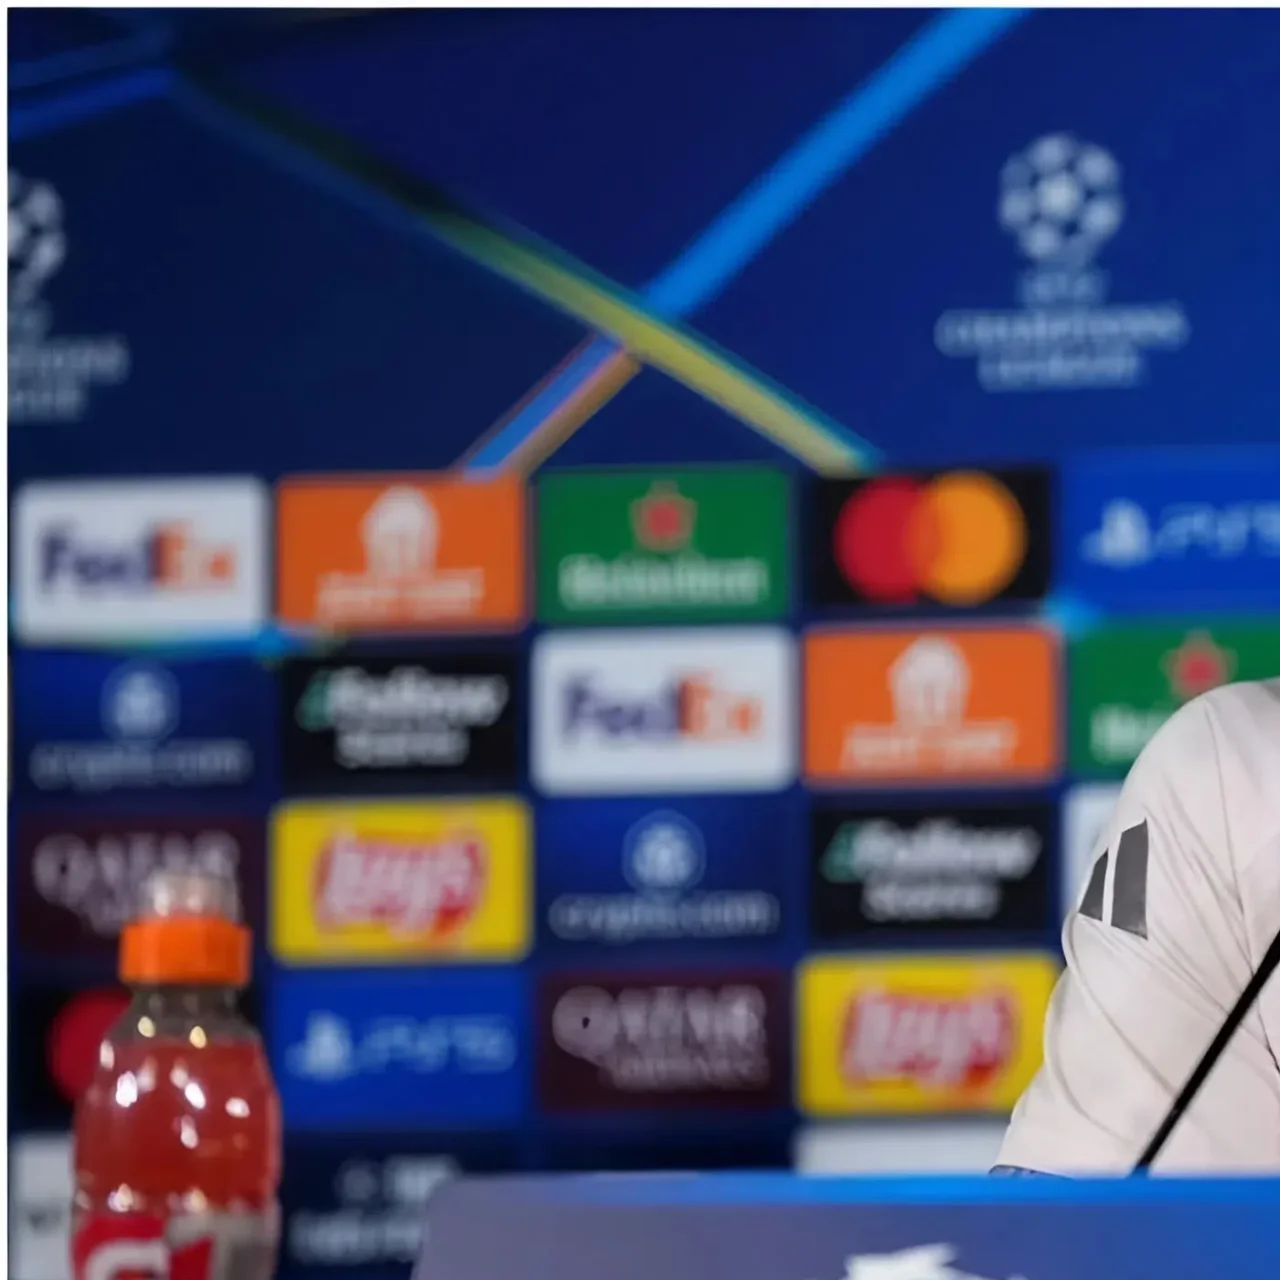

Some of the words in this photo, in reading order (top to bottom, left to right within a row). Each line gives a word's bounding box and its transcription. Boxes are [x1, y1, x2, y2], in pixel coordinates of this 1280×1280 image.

[42, 521, 236, 594] FedEx
[563, 676, 761, 746] FedEx
[550, 893, 779, 941] crypto.com
[360, 1015, 515, 1071] PS5
[552, 987, 767, 1054] QATAR
